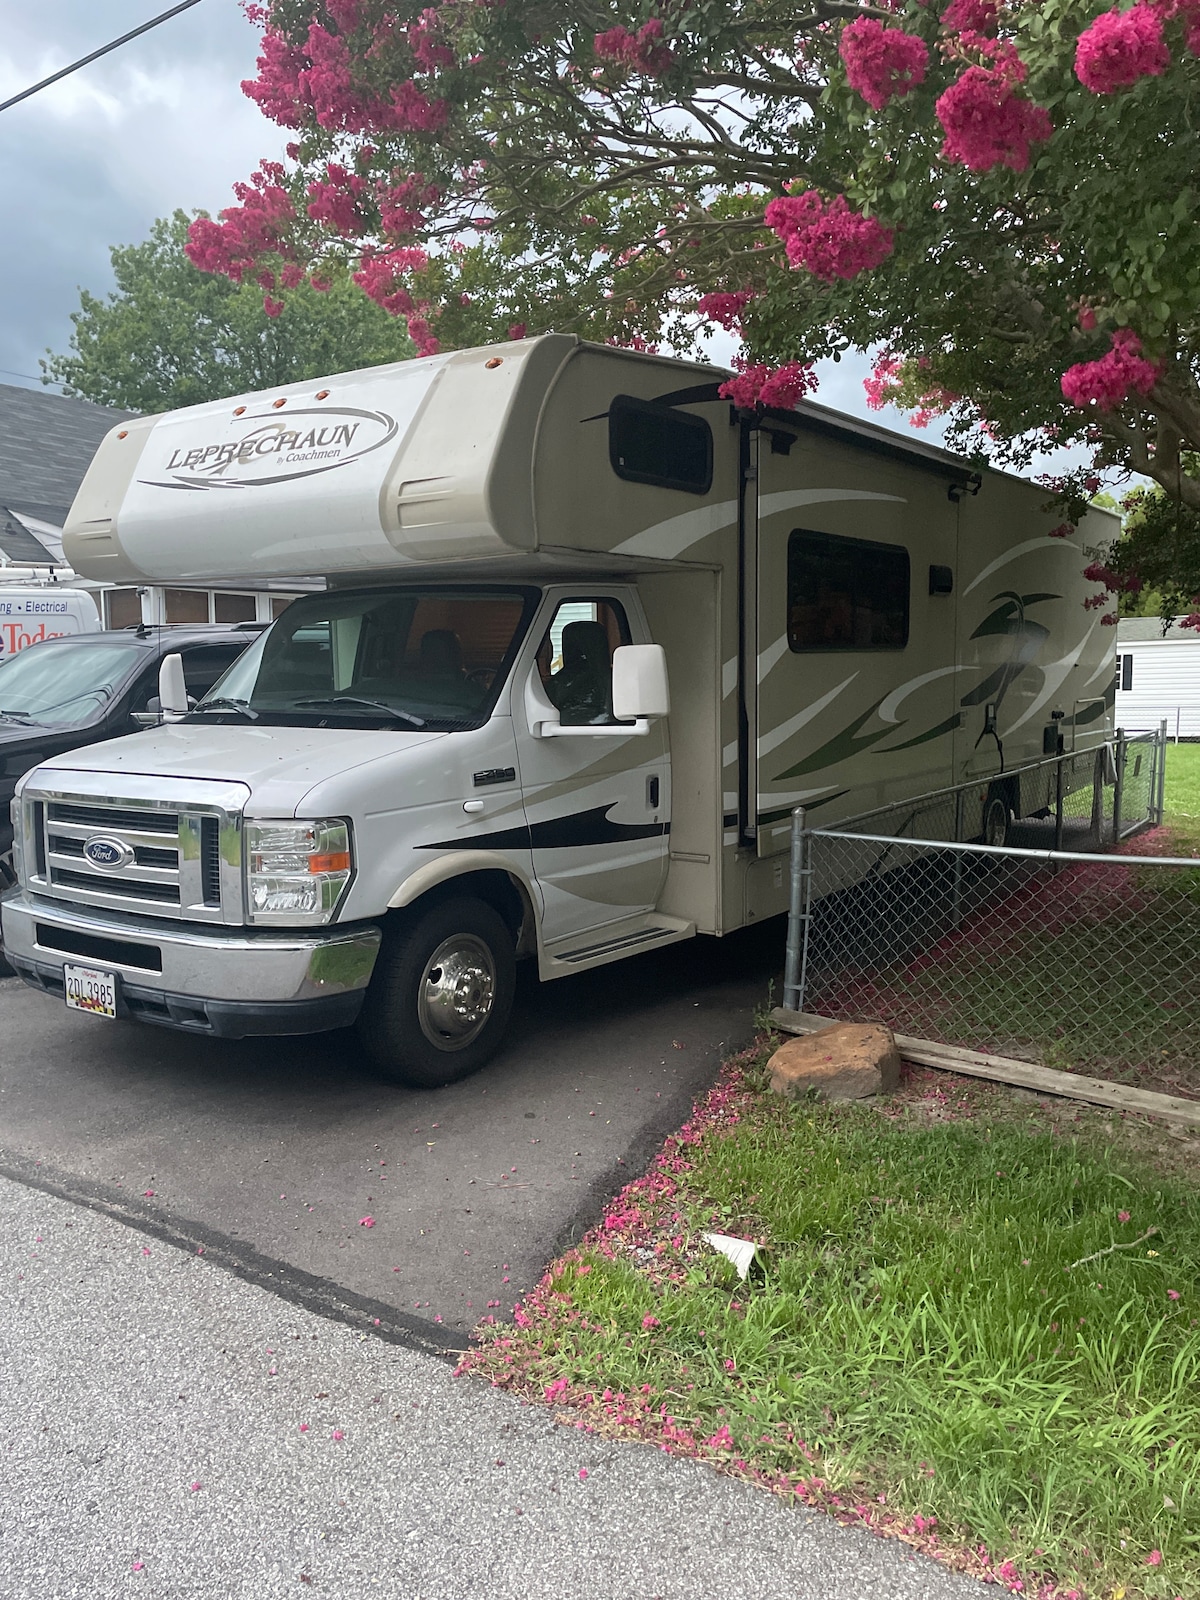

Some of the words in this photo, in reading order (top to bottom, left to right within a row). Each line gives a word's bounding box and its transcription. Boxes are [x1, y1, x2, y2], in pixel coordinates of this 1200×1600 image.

[165, 422, 360, 471] LEPRECHAUN
[286, 449, 341, 463] Coachmen
[25, 600, 68, 613] Electrical
[91, 844, 112, 860] Ford
